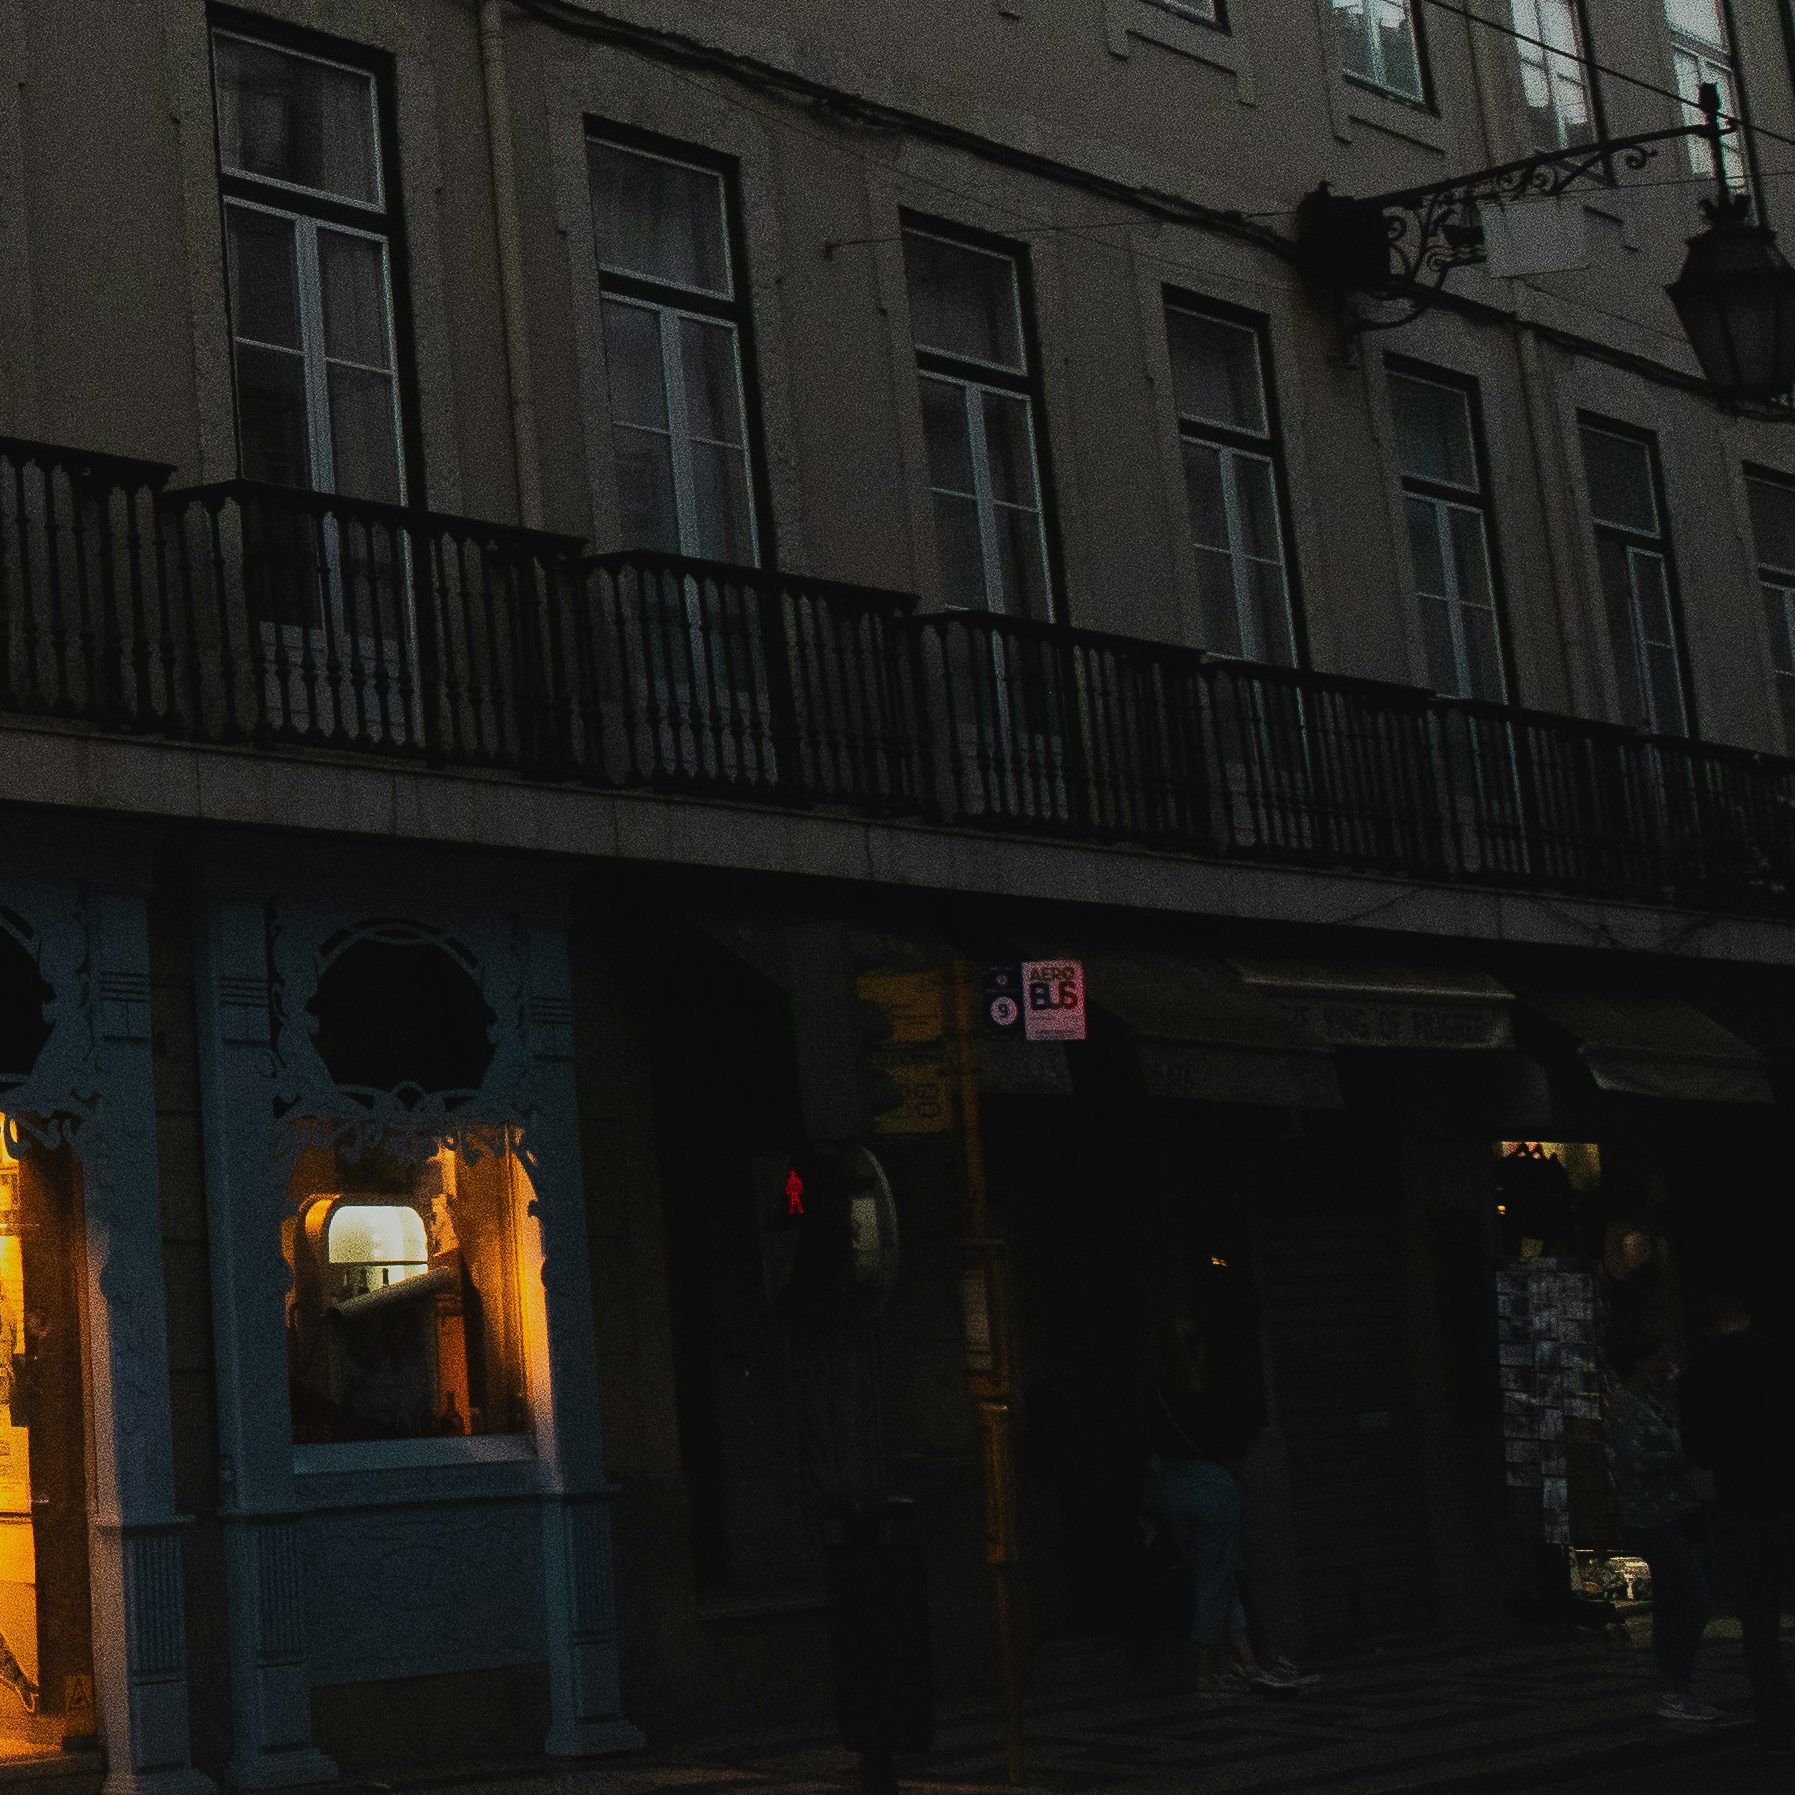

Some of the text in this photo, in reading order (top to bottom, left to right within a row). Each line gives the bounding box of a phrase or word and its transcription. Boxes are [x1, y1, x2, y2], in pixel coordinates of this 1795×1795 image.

[1030, 967, 1075, 981] AERO
[1030, 981, 1078, 1011] BUS
[997, 1003, 1009, 1018] 9
[1321, 1004, 1370, 1038] KING
[1380, 1008, 1401, 1040] OF
